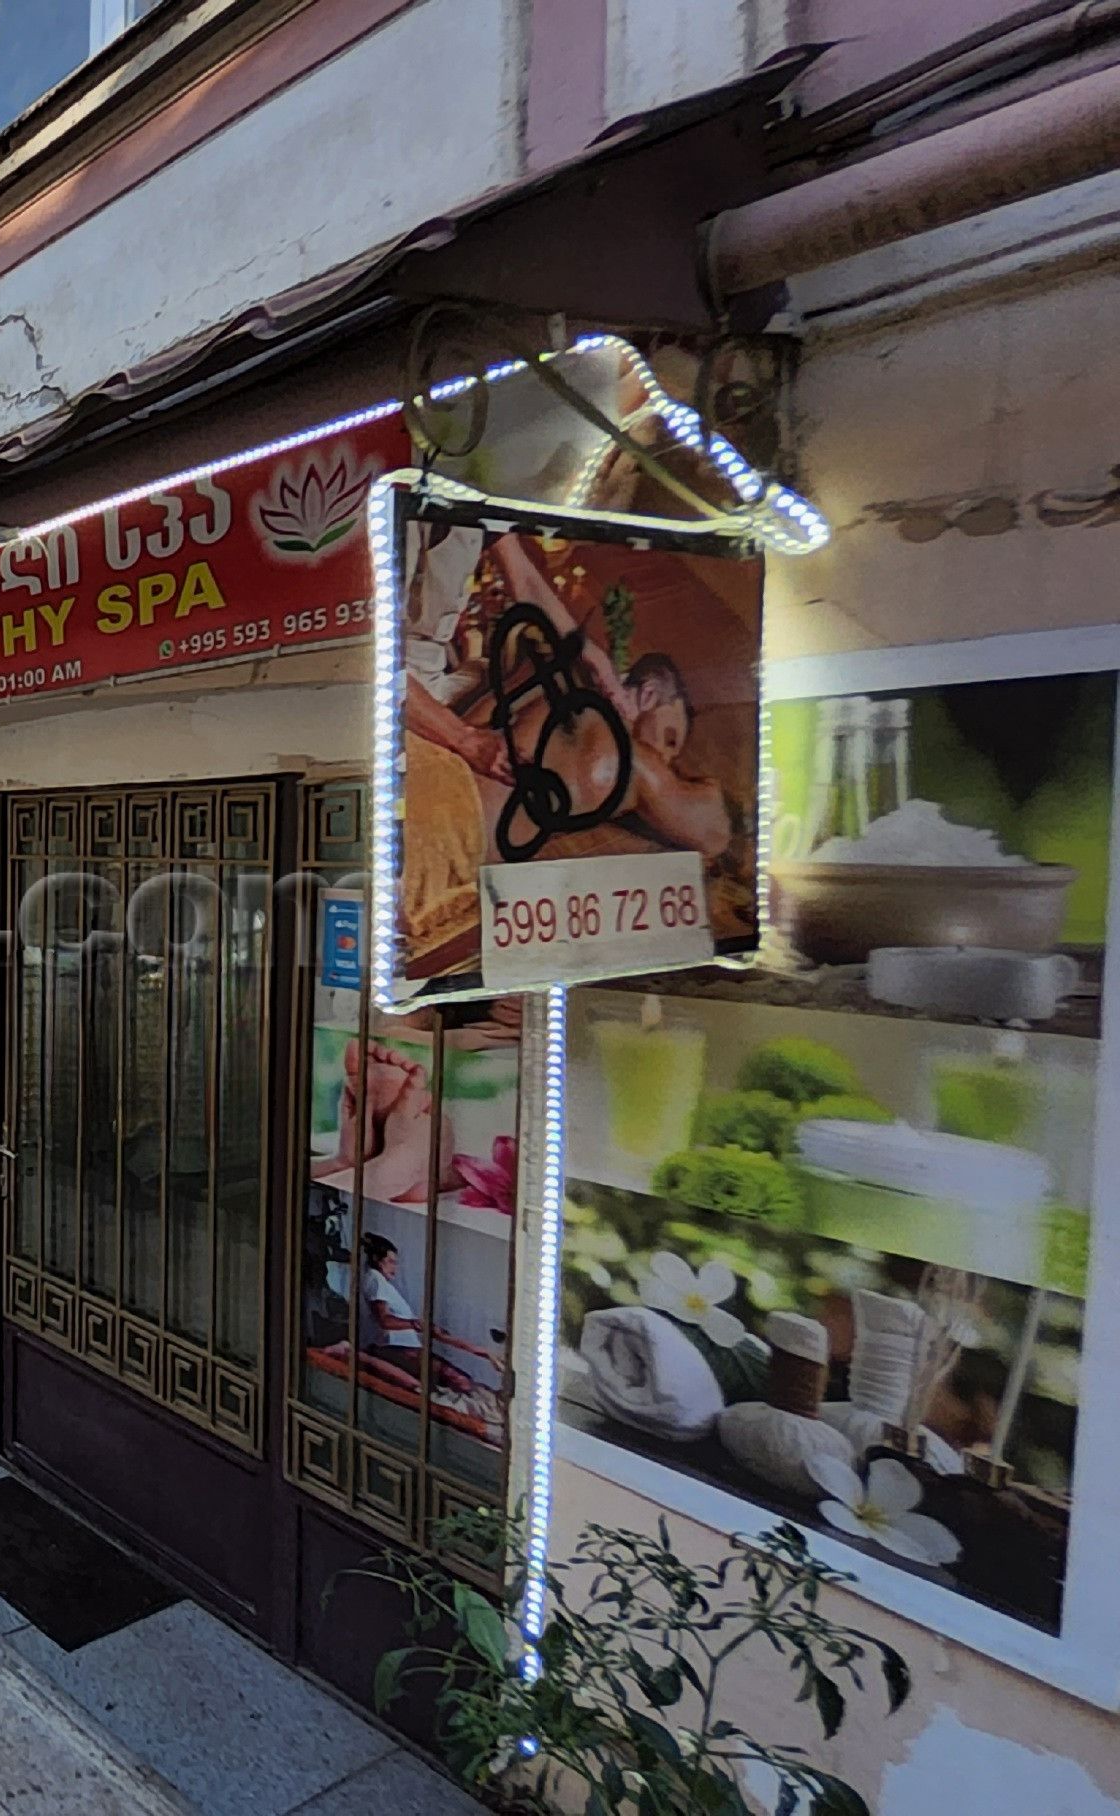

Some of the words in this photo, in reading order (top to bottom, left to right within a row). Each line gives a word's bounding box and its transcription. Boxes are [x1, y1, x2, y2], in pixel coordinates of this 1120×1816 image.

[96, 562, 225, 635] SPA
[179, 629, 226, 655] +995
[233, 619, 270, 646] 593
[283, 607, 327, 635] 965
[51, 660, 82, 684] AM
[493, 898, 557, 948] 599
[567, 893, 601, 939] 86
[612, 889, 649, 932] 72
[659, 885, 699, 927] 68
